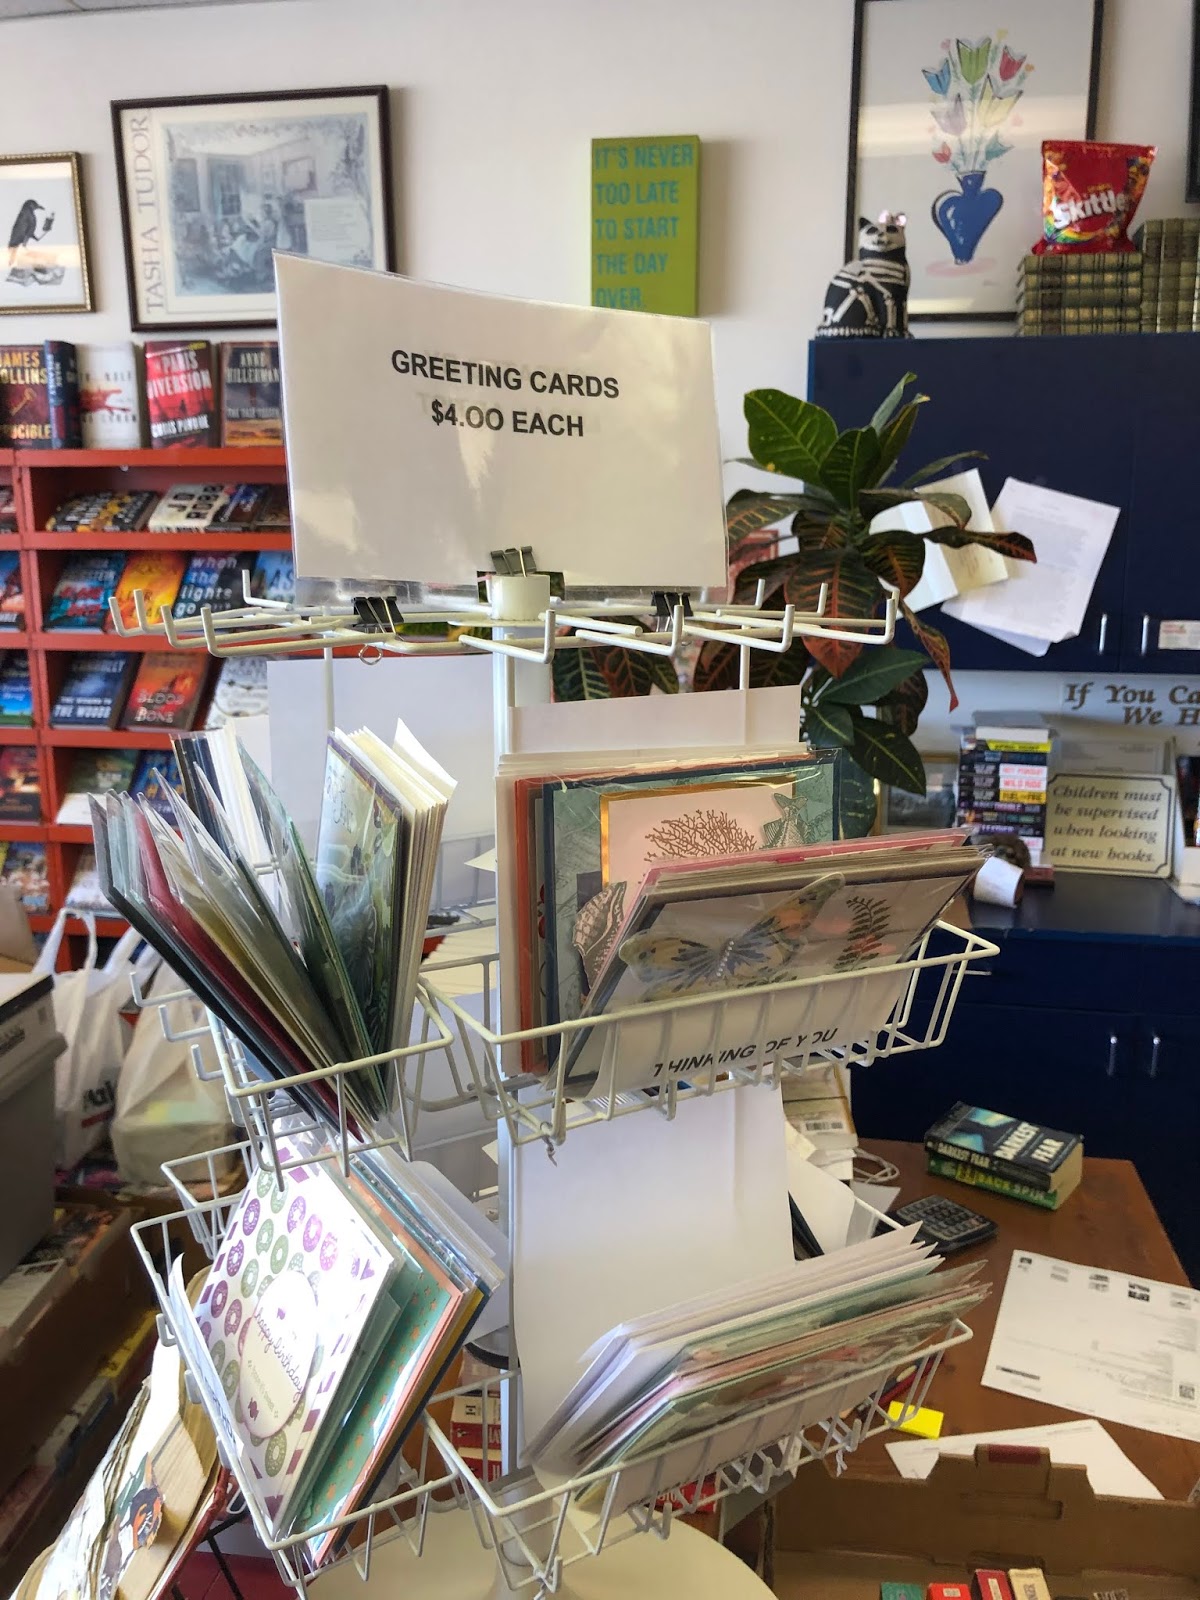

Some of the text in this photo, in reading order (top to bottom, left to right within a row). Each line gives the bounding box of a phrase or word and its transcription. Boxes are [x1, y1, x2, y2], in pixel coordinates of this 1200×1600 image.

[594, 143, 694, 169] IT'S NEVER
[595, 180, 679, 205] TOO LATE
[130, 115, 164, 314] TASHA TUDOR
[1050, 190, 1128, 230] Skittle
[595, 216, 679, 241] TO START
[596, 252, 669, 276] THE DAY
[594, 286, 642, 309] OVER
[0, 351, 40, 368] AMES
[0, 368, 48, 385] OLLINS
[391, 349, 620, 399] GREETING CARDS
[431, 398, 584, 437] $4.00 EACH
[1064, 681, 1094, 710] If
[1103, 684, 1157, 705] You
[1122, 706, 1163, 726] We
[1053, 784, 1162, 802] Children must
[1054, 803, 1072, 816] be
[1076, 806, 1160, 821] supervised
[1053, 823, 1094, 837] when
[1099, 824, 1158, 845] looking
[1050, 846, 1067, 858] at
[653, 1027, 839, 1078] THINKING OF YOU
[253, 1306, 275, 1354] happy
[273, 1336, 303, 1403] birthday
